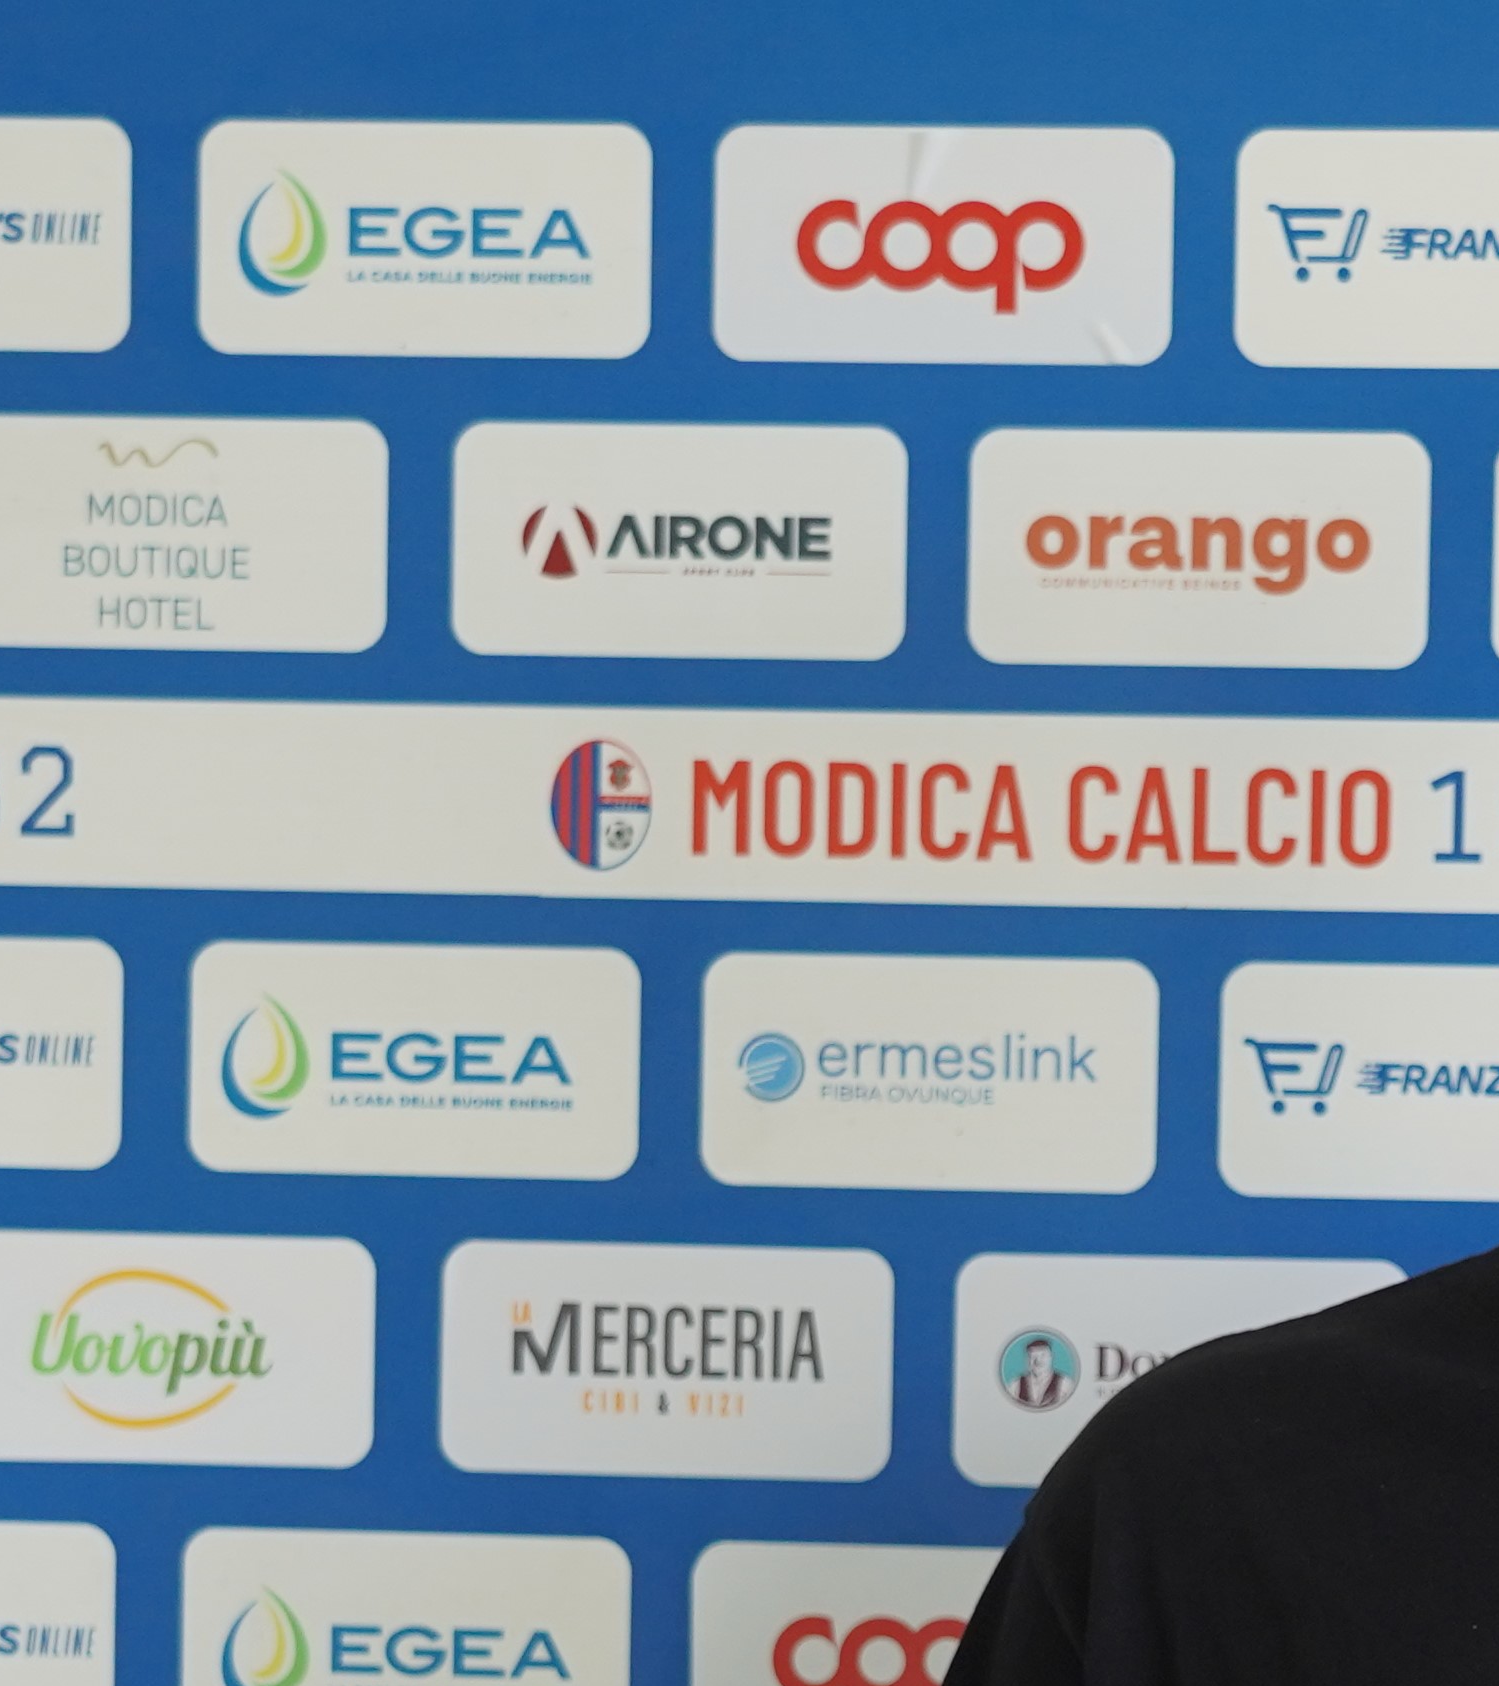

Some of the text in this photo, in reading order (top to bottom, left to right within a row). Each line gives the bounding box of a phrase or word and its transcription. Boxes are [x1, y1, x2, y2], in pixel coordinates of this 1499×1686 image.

[347, 205, 590, 259] EGEA
[795, 198, 1086, 315] coop
[85, 492, 228, 528] MODICA
[61, 543, 250, 581] BOUTIQUE
[1024, 513, 1372, 596] orango
[96, 595, 215, 632] HOTEL
[691, 758, 1032, 862] MODICA
[1067, 764, 1392, 869] CALCIO
[330, 1031, 571, 1086] EGEA
[815, 1032, 1097, 1090] ermeslink
[818, 1082, 882, 1103] FIBRA
[510, 1300, 828, 1386] MERCERIA
[330, 1624, 571, 1681] EGEA
